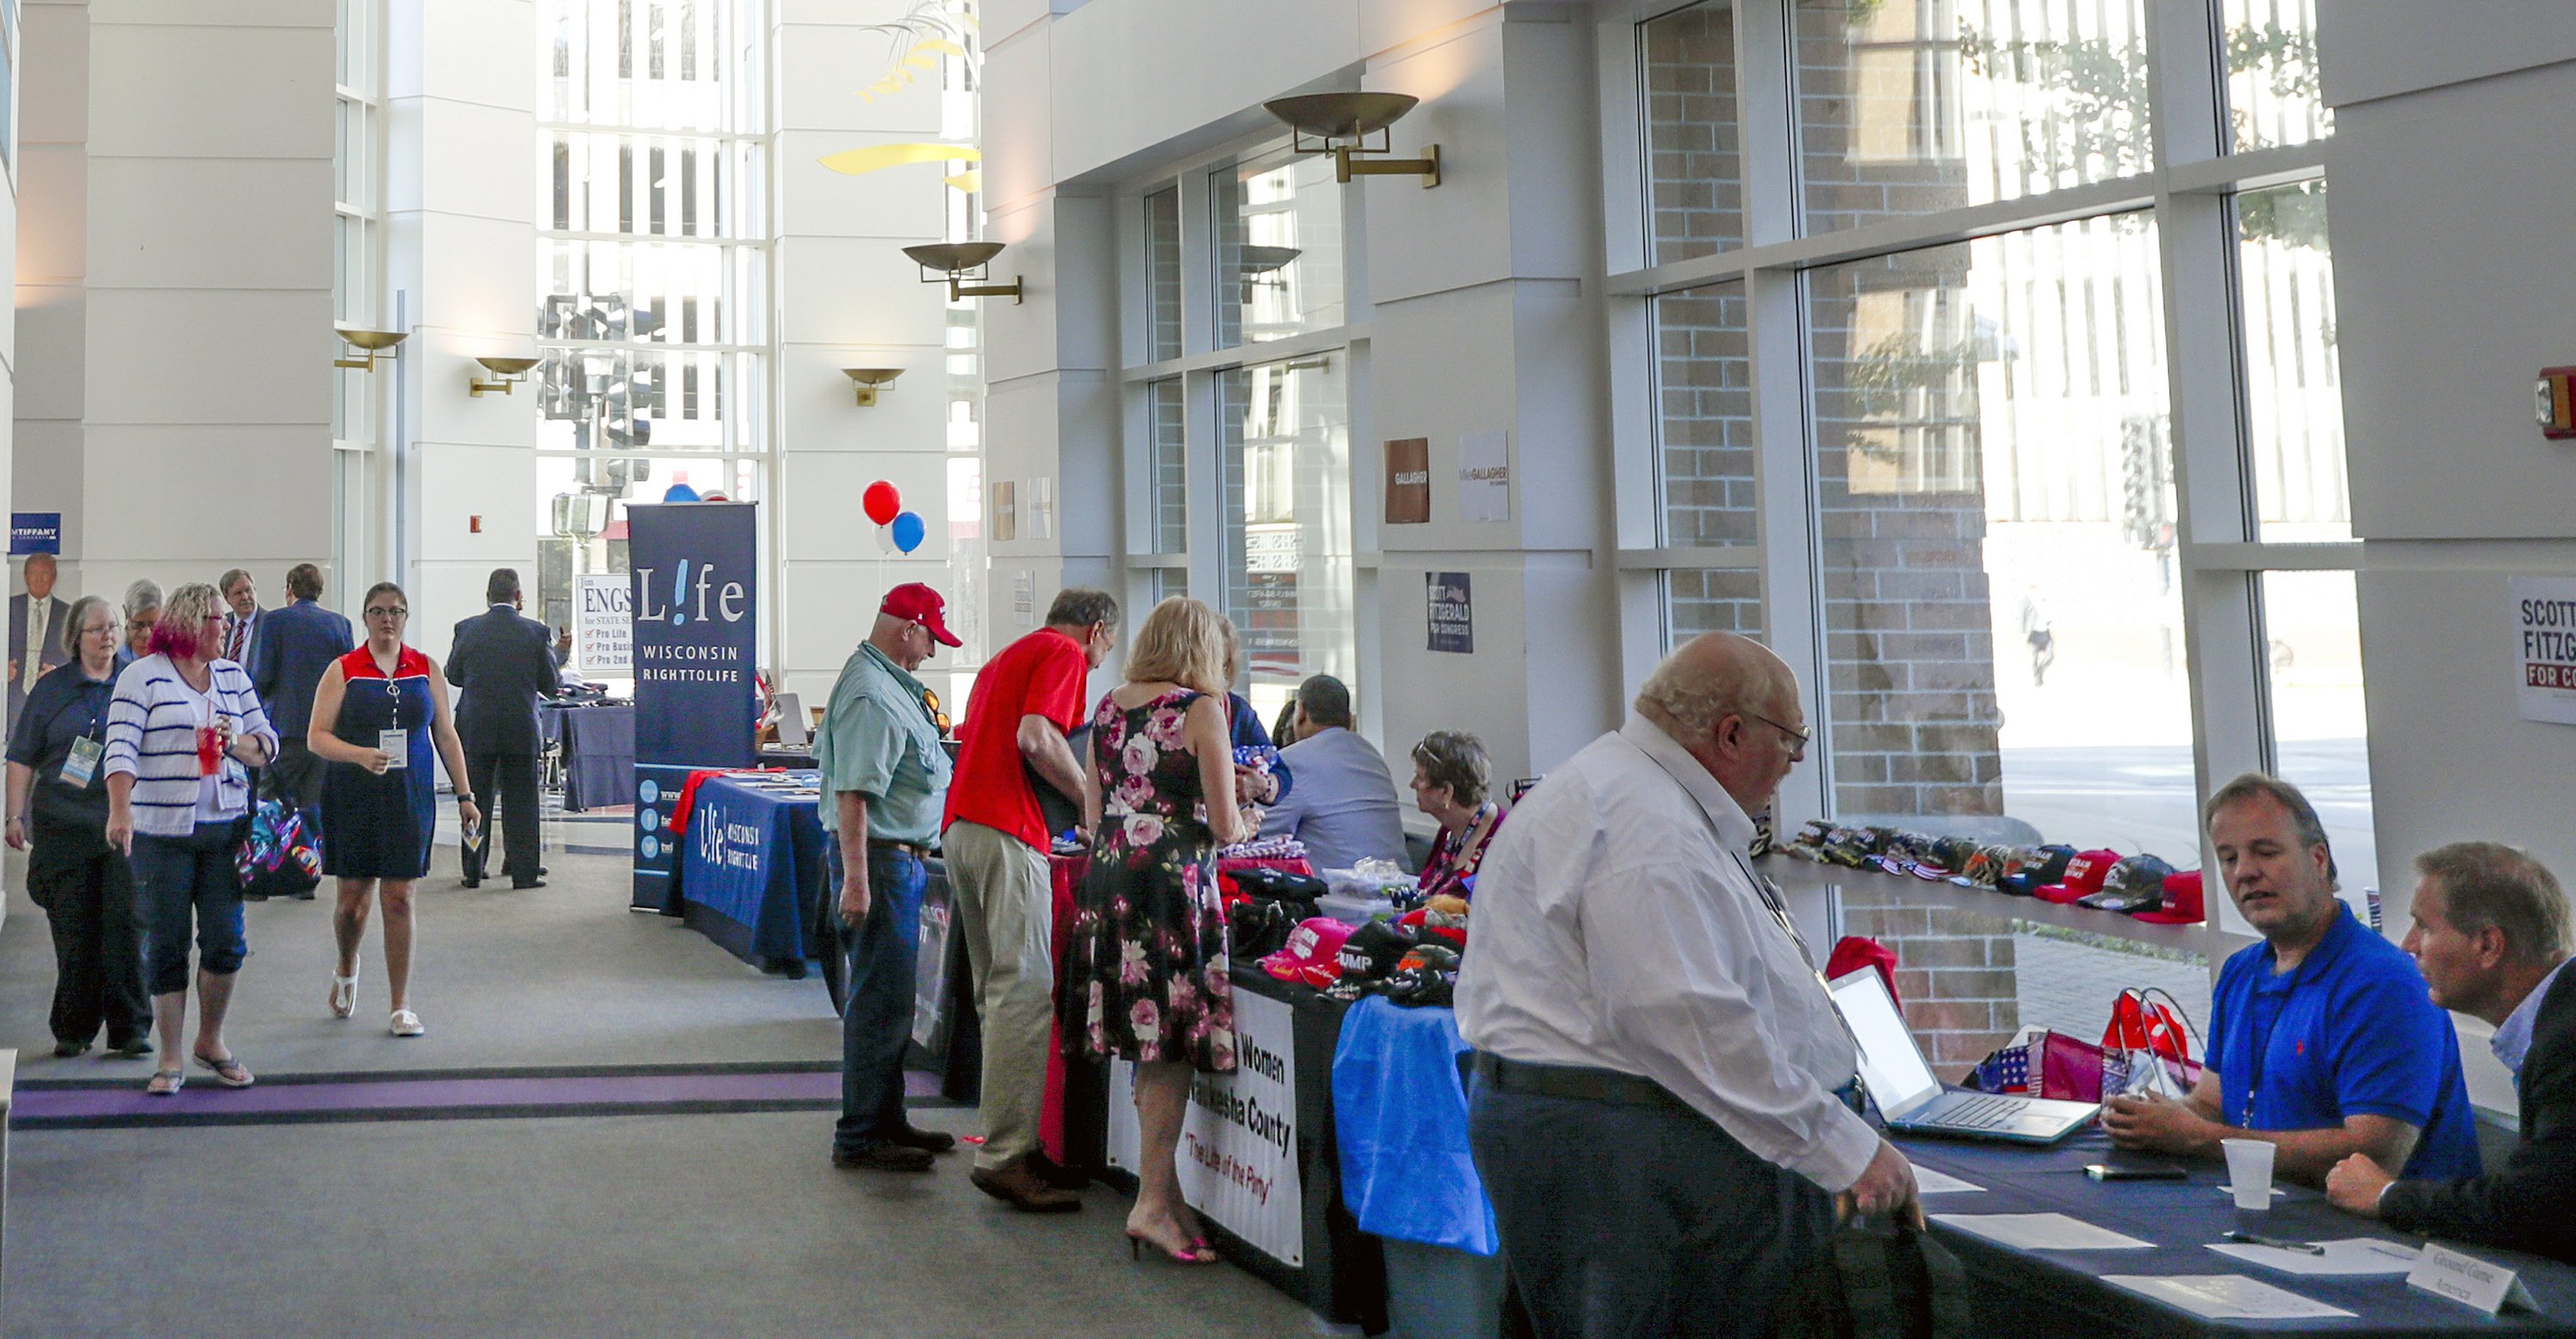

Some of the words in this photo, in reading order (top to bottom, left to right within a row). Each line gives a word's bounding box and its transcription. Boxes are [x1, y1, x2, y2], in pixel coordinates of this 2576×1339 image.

[580, 577, 594, 589] Jim
[596, 616, 619, 625] STATE
[2521, 600, 2576, 628] SCOTT
[596, 629, 610, 638] Pro
[611, 629, 627, 638] Life
[597, 642, 611, 651] Pro
[643, 645, 738, 660] WISCONSIN
[597, 654, 611, 665] Pro
[613, 654, 628, 665] 2nd
[2528, 666, 2557, 685] FOR
[1335, 950, 1373, 972] UMP
[1241, 1032, 1285, 1085] Women
[1248, 1095, 1291, 1158] County
